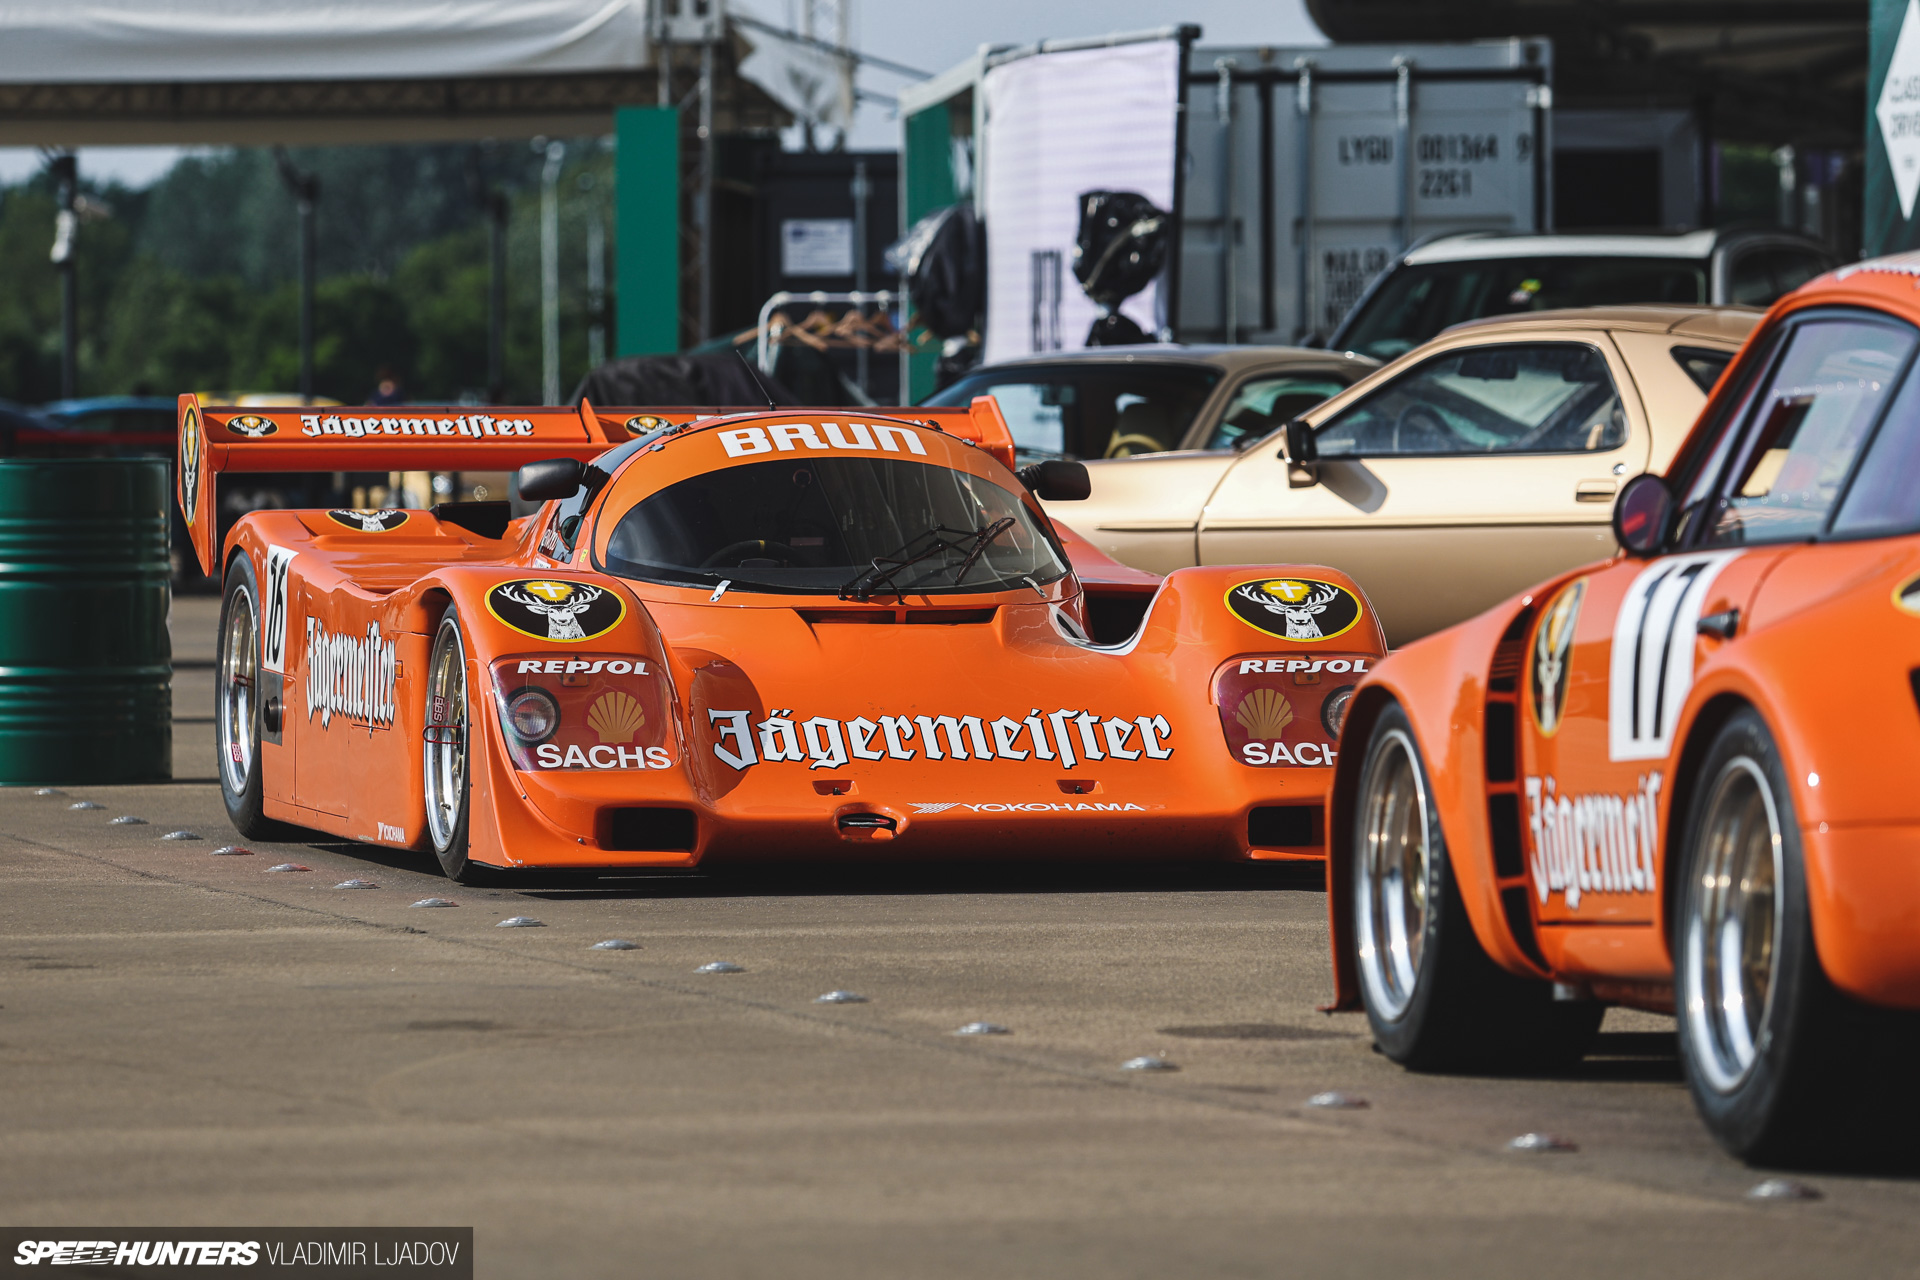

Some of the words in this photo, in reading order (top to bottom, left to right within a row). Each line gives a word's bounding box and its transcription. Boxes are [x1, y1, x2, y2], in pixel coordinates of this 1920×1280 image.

[1338, 135, 1394, 166] LYGU
[1416, 134, 1499, 164] 001364
[717, 422, 928, 458] BRUN
[266, 552, 288, 665] 16
[1632, 561, 1712, 740] 11
[517, 660, 650, 675] REPSOL
[1238, 659, 1369, 675] REPSOL
[536, 743, 672, 770] SACHS
[962, 803, 1147, 812] YOKOHAMA
